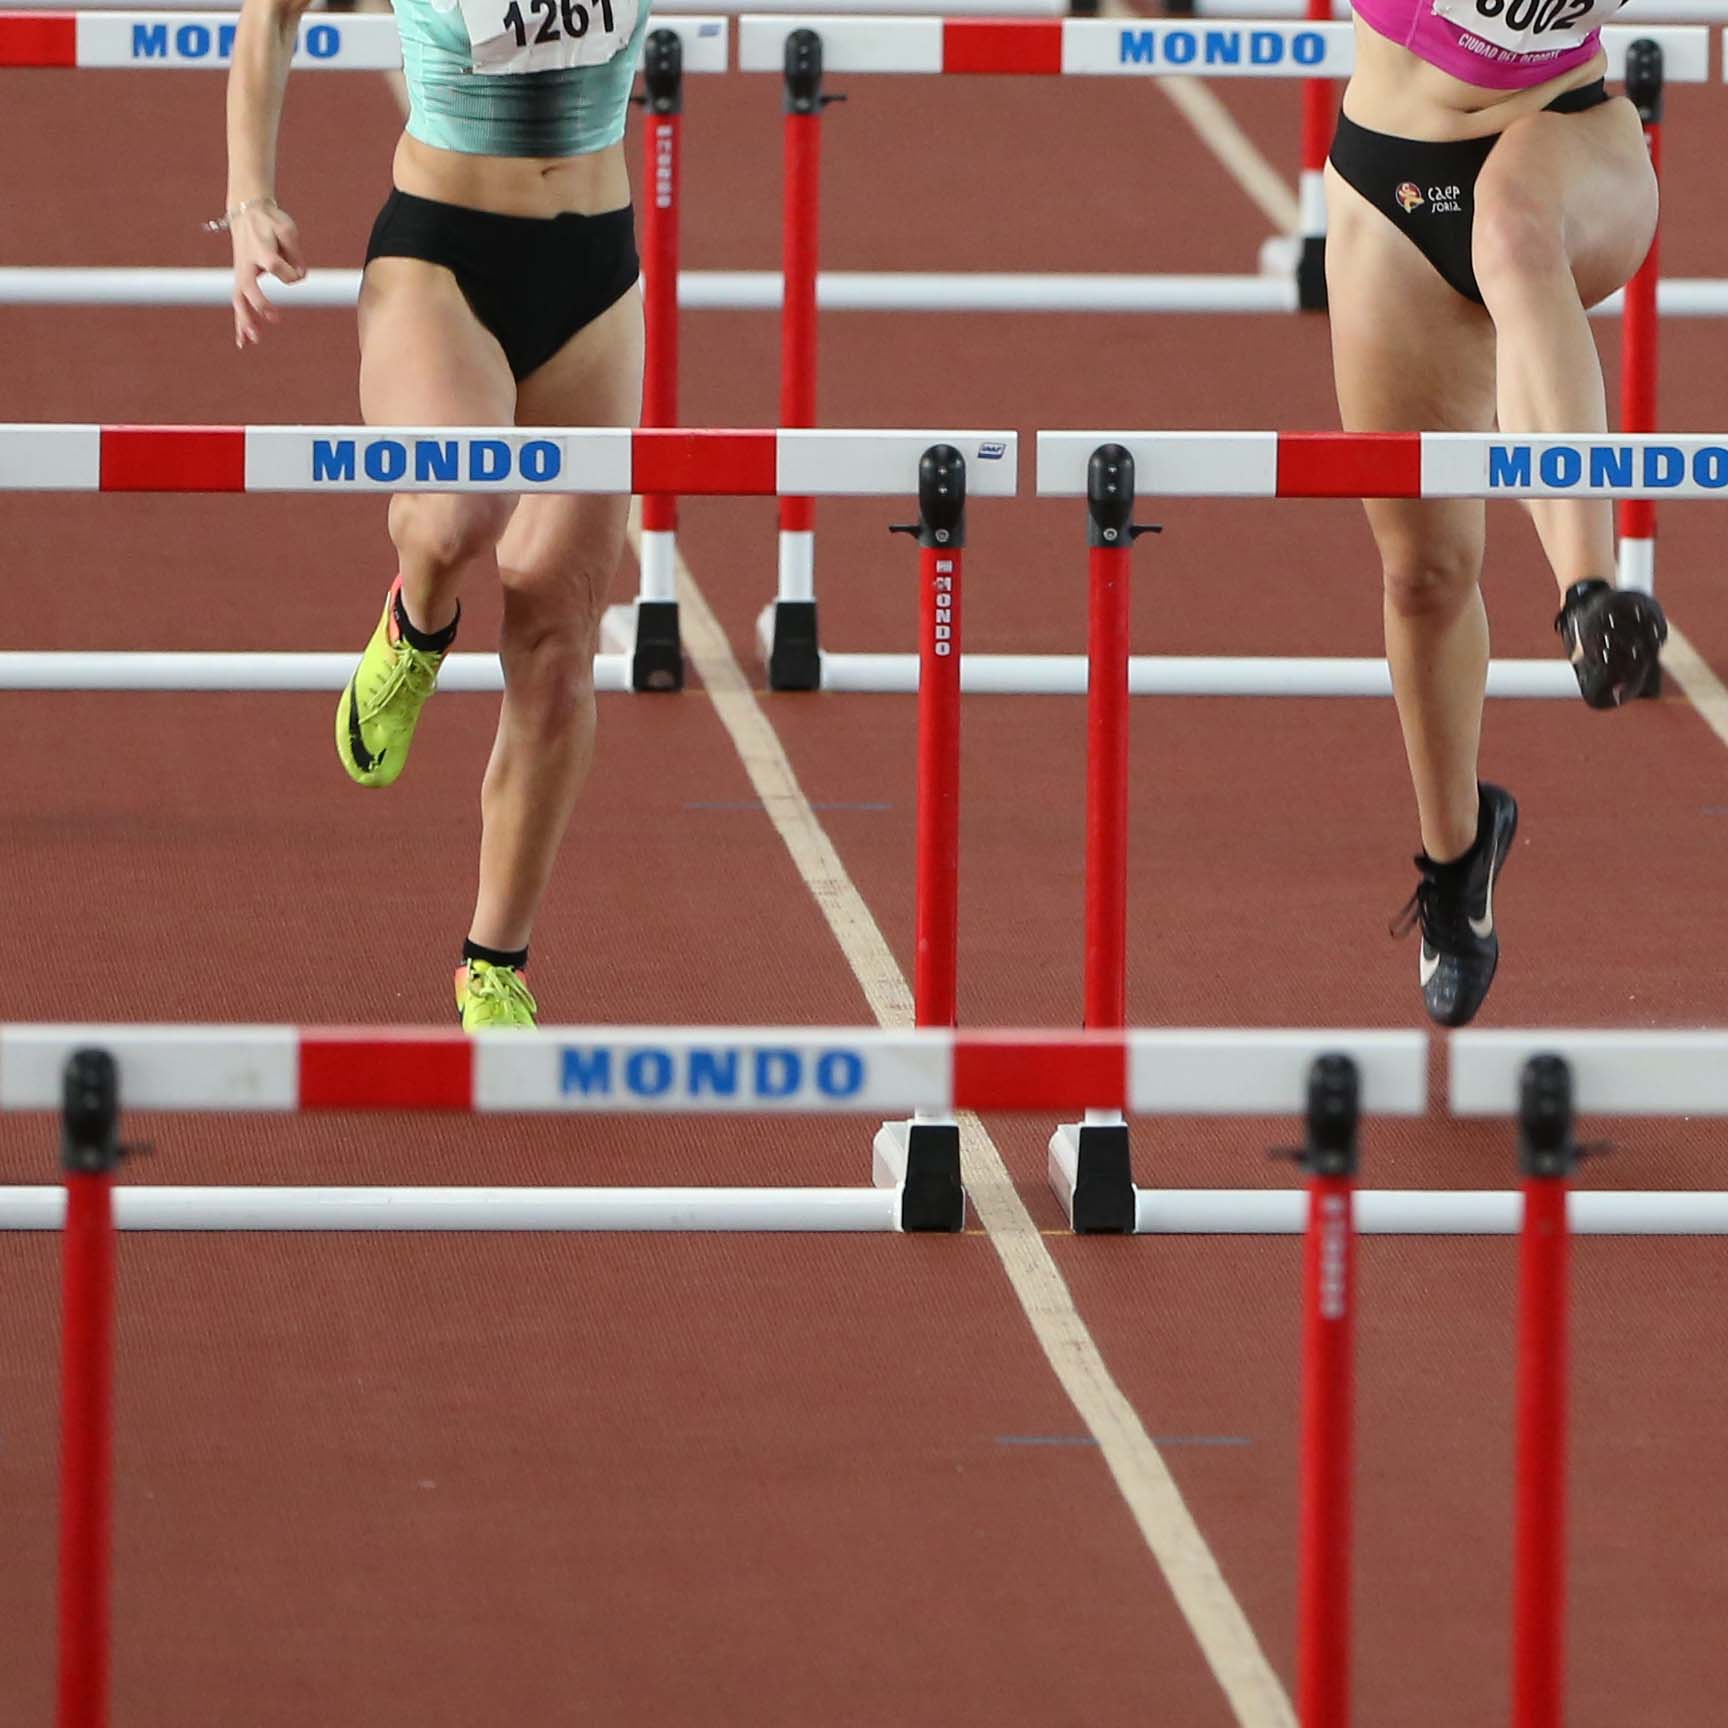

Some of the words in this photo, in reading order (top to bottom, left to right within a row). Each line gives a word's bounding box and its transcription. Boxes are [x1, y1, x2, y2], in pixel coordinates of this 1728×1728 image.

[132, 24, 341, 59] MOO
[1120, 30, 1327, 66] MONDO
[1458, 33, 1499, 59] CIUDAD
[312, 439, 561, 482] MONDO
[559, 1046, 867, 1099] MONDO
